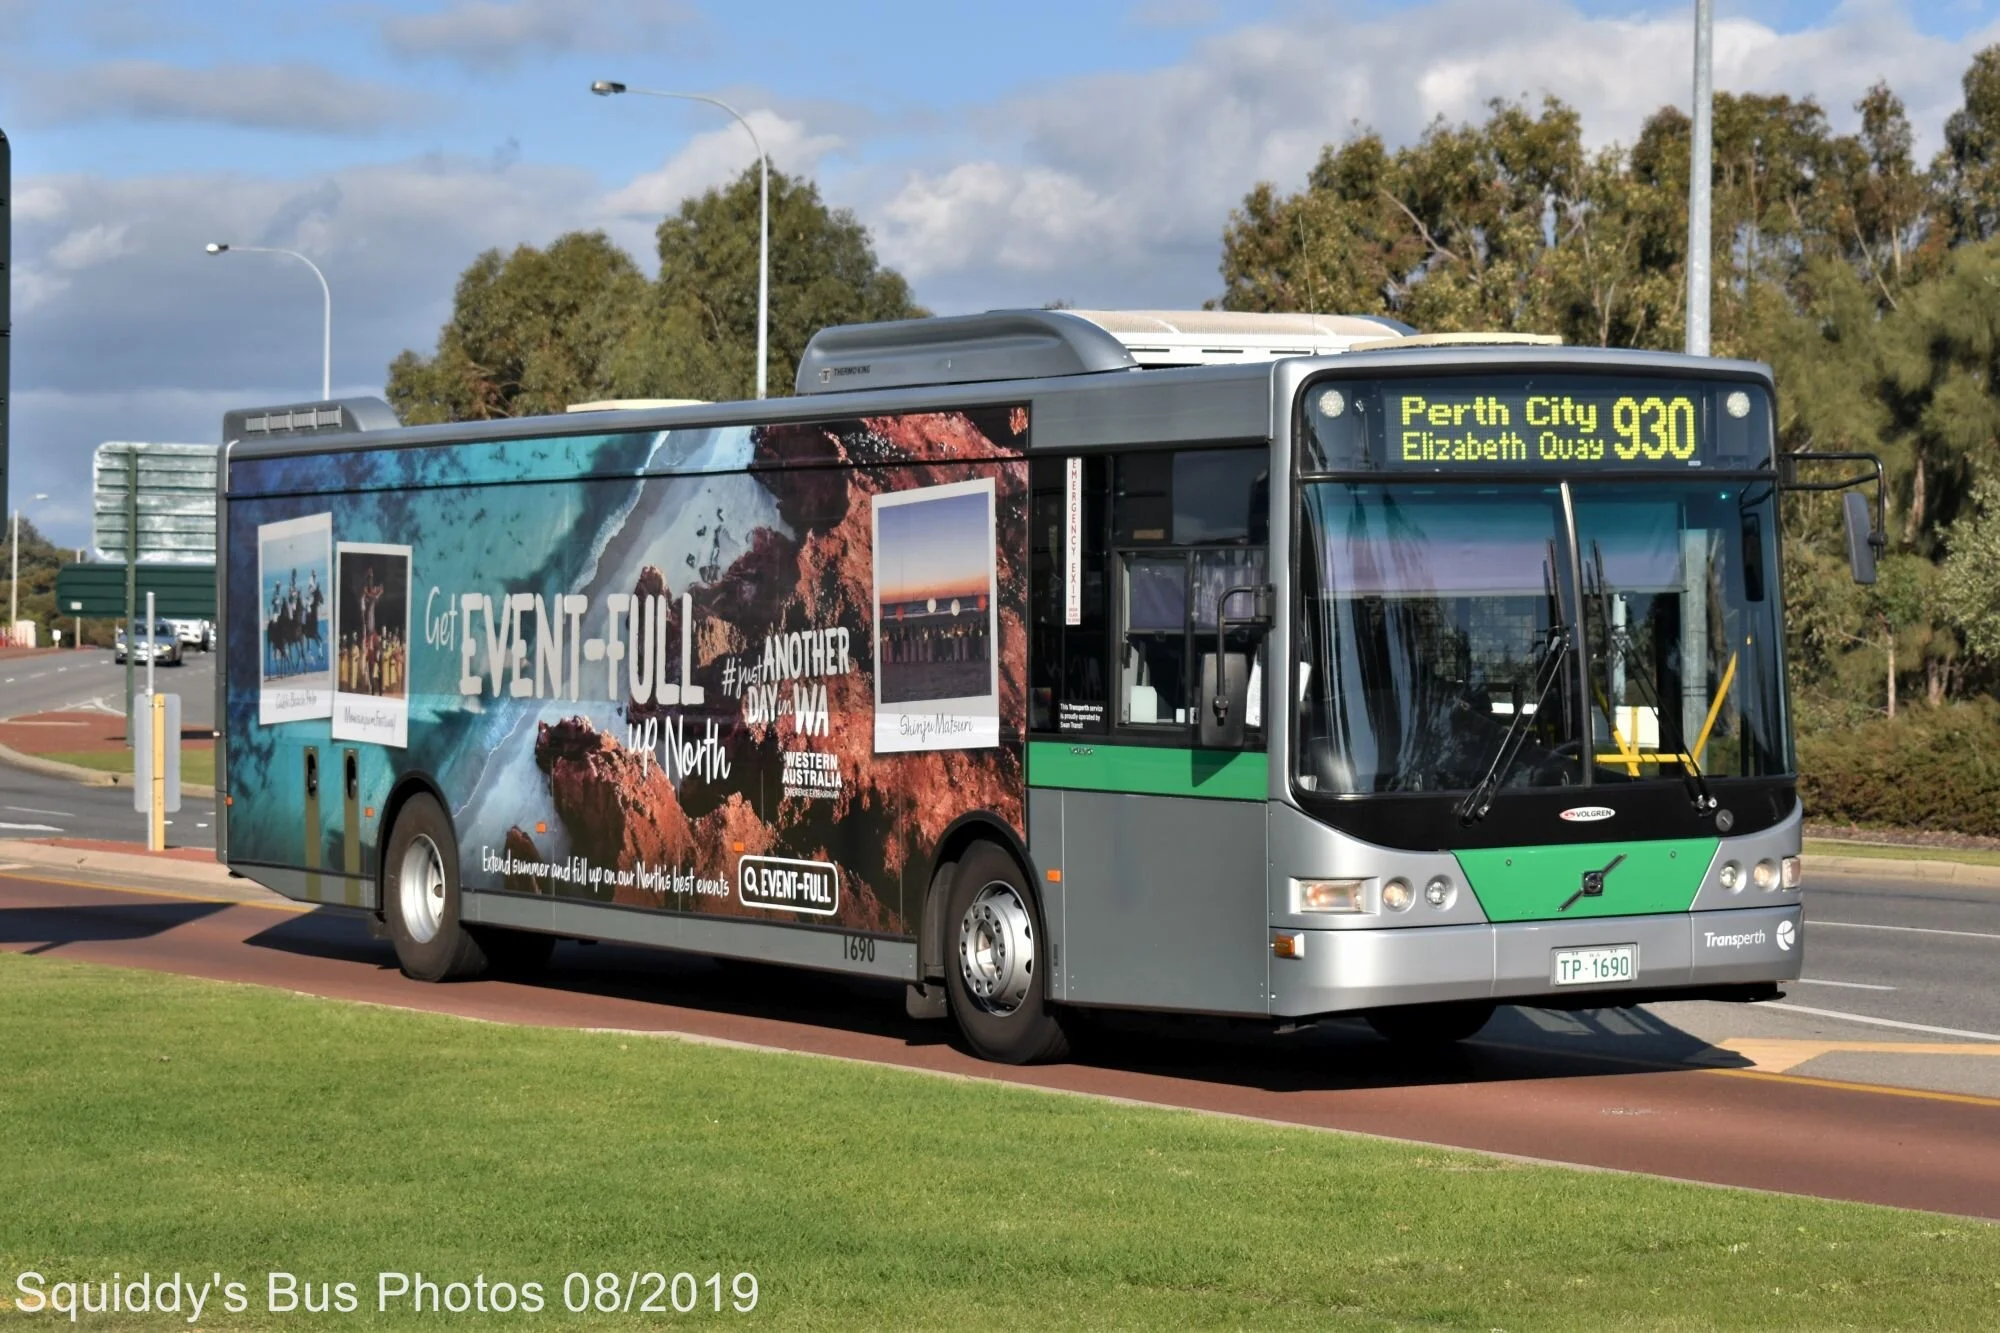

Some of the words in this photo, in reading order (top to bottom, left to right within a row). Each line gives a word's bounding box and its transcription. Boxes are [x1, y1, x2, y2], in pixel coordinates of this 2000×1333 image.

[1402, 396, 1509, 425] Perth
[1526, 396, 1597, 433] City
[1613, 397, 1695, 459] 930
[1402, 432, 1526, 460] Elizabeth
[1539, 432, 1603, 460] Quay
[425, 585, 458, 651] Get
[459, 592, 705, 706] EVENT-FULL
[721, 654, 763, 699] #just
[763, 626, 850, 682] ANOTHER
[747, 683, 778, 724] DAY
[777, 692, 793, 716] in
[793, 682, 830, 737] WA
[900, 714, 934, 743] Shinju
[935, 712, 973, 735] Matsuri
[627, 716, 658, 777] up
[664, 715, 731, 784] North
[783, 751, 838, 770] WESTERN
[782, 768, 842, 788] AUSTRALIA
[482, 846, 510, 875] Extend
[512, 857, 549, 877] summer
[551, 856, 570, 881] and
[572, 857, 587, 886] fill
[589, 866, 602, 892] up
[604, 869, 616, 884] on
[617, 870, 634, 885] our
[636, 861, 671, 893] North's
[673, 865, 694, 896] best
[696, 871, 729, 898] events
[761, 868, 831, 903] EVENT-FULL
[844, 935, 875, 962] 1690
[1704, 929, 1765, 949] Transperth
